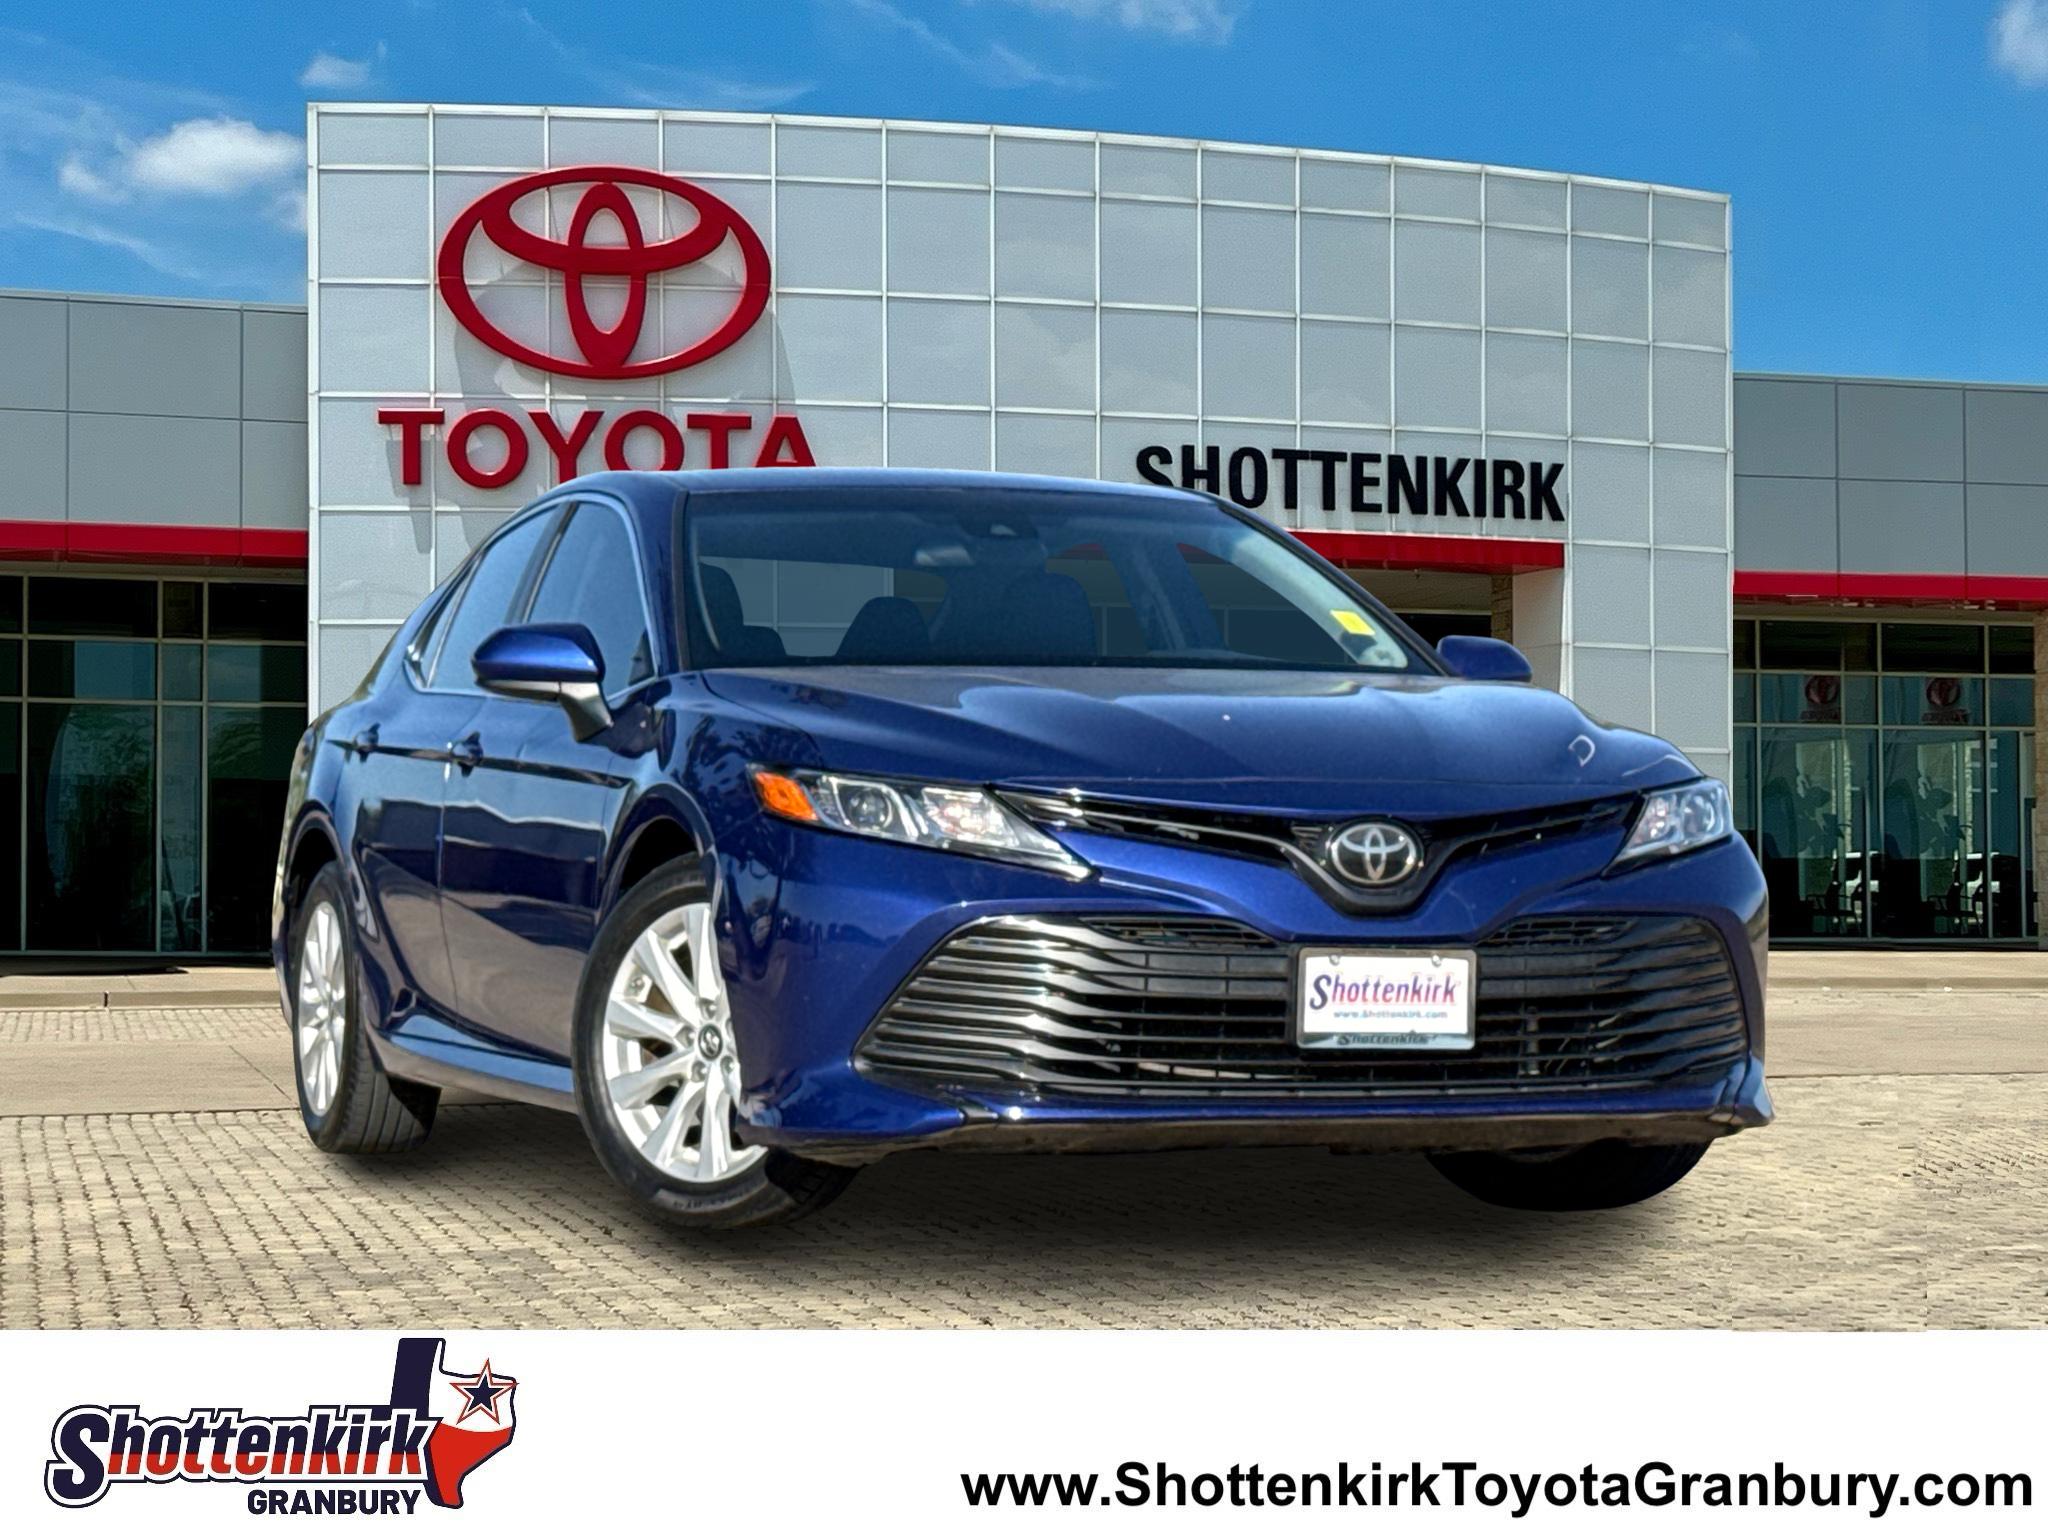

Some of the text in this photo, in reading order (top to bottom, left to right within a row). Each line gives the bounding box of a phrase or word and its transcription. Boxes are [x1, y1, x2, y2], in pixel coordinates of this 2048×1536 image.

[378, 408, 816, 488] TOYOTA
[1136, 445, 1565, 522] SHOTTENKIRK
[1309, 972, 1457, 1010] Shottenkirk
